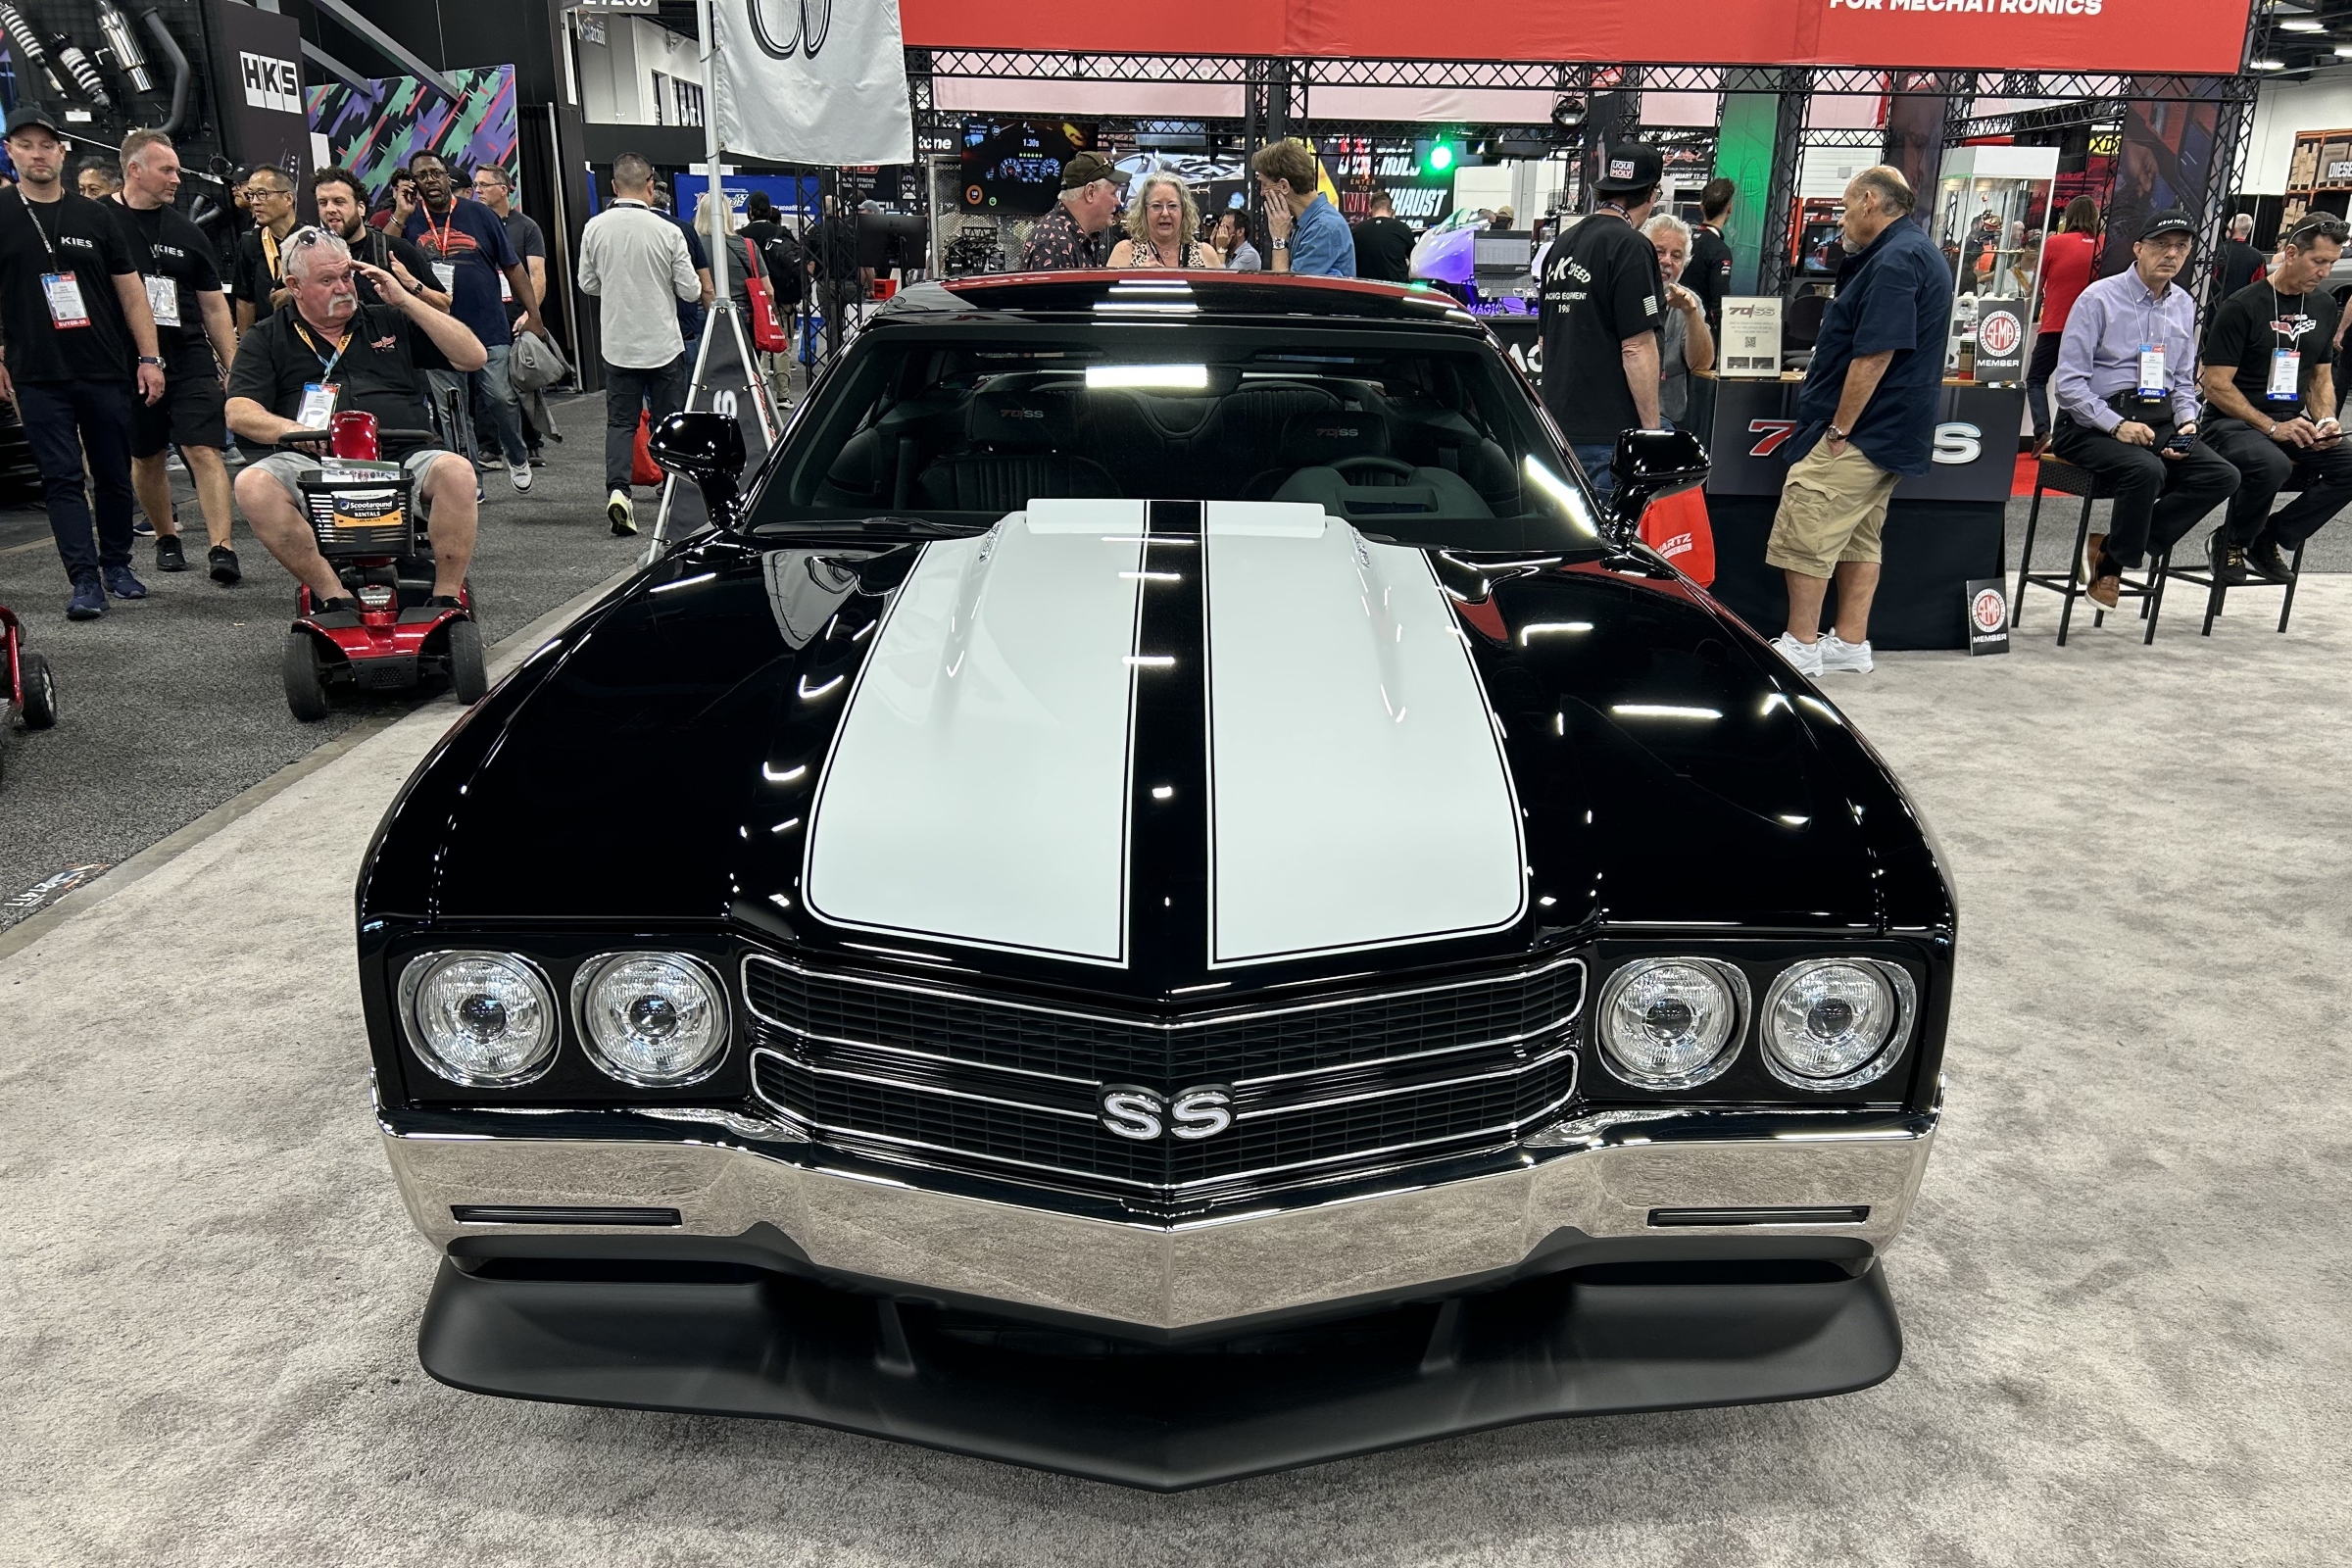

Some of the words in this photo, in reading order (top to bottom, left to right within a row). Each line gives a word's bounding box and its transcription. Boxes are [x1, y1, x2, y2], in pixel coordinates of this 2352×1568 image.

[242, 56, 298, 97] HKS
[1611, 169, 1632, 177] MOLY
[1612, 162, 1633, 171] LIQUI
[1343, 191, 1371, 214] WI
[1385, 188, 1448, 218] HAUST
[61, 236, 93, 248] KIES
[154, 244, 184, 258] KIES
[1985, 318, 2015, 350] SEMA
[1977, 359, 2020, 368] MEMBER
[350, 501, 392, 510] Scootaround
[1656, 532, 1692, 556] ARTZ
[1978, 596, 2000, 625] SEMA
[1973, 633, 2007, 643] MEMBER
[1102, 1090, 1233, 1142] SS
